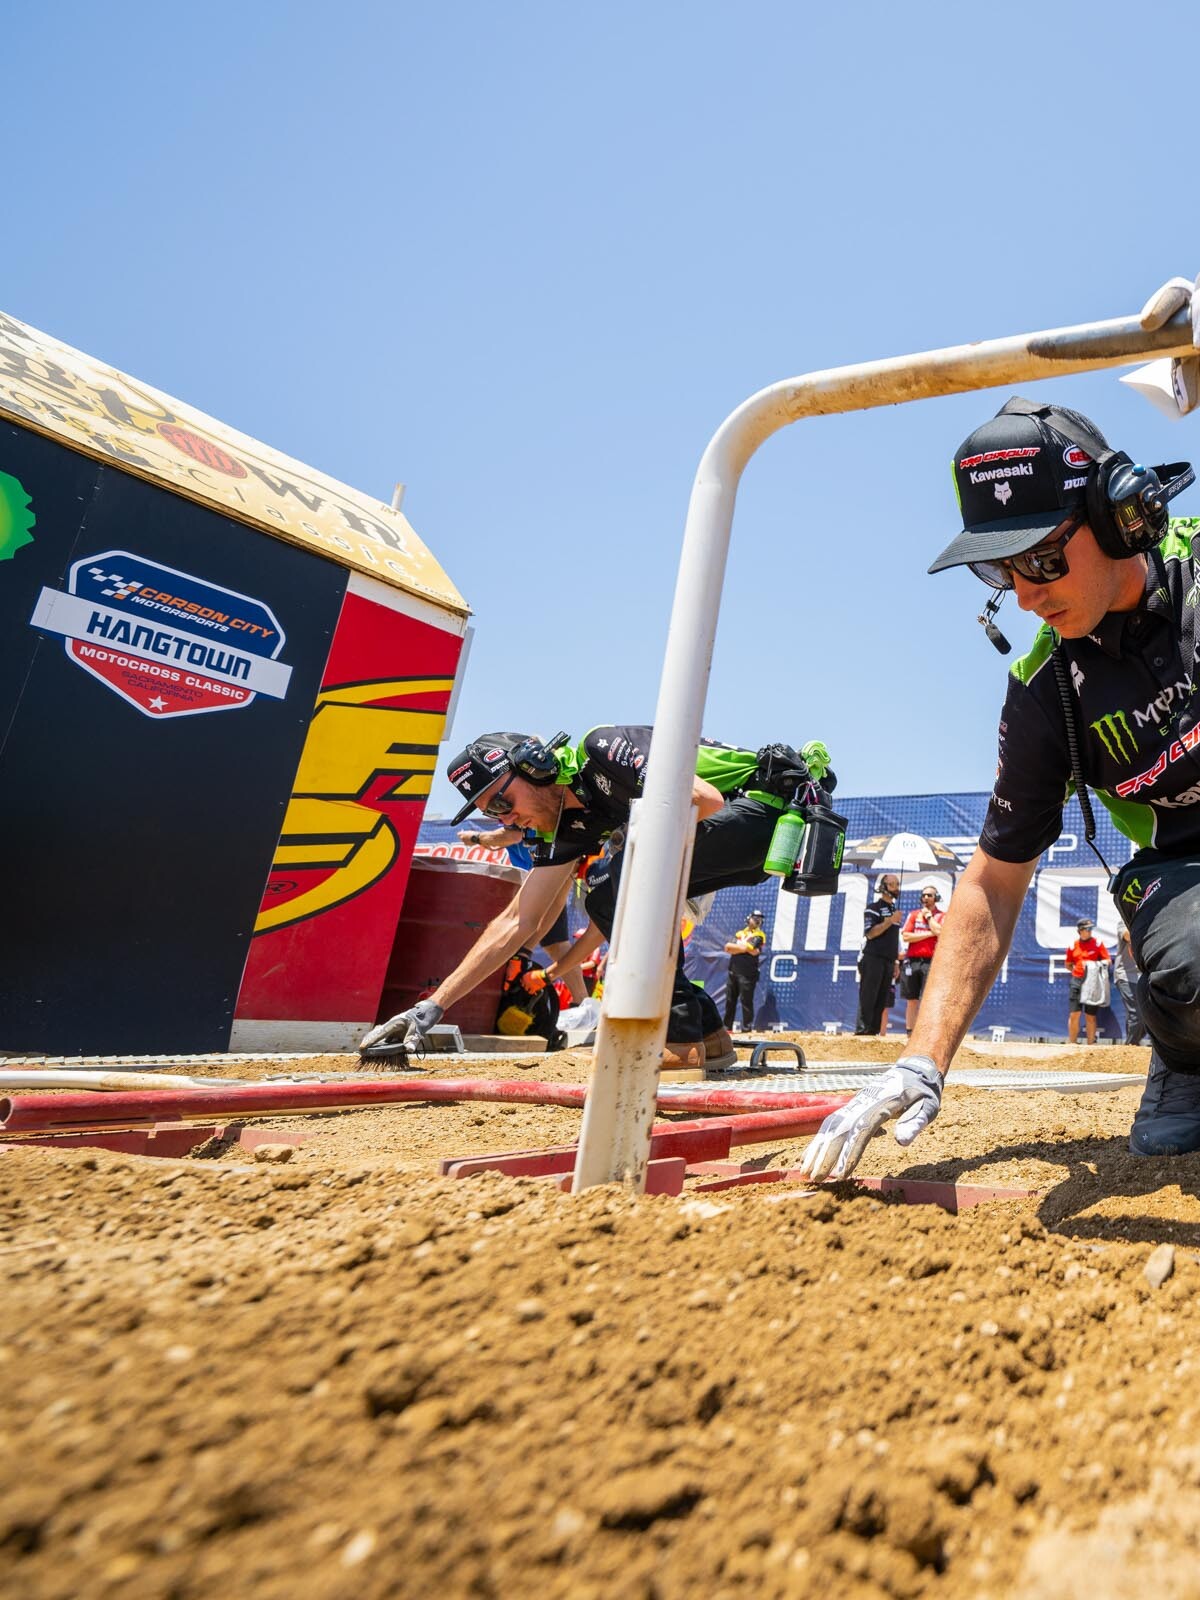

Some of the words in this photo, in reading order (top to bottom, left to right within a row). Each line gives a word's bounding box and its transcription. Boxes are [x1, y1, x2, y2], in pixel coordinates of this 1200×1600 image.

[970, 463, 1034, 484] Kawasaki
[1069, 451, 1093, 463] BEL
[1063, 477, 1088, 490] DUN
[130, 596, 230, 633] MOTORSPORTS
[138, 588, 230, 623] CARSON
[229, 617, 275, 639] CITY
[86, 611, 252, 681] HANGTOWN
[79, 646, 181, 682] MOTOCROSS
[185, 676, 245, 700] CLASSIC
[1116, 750, 1168, 798] PRO
